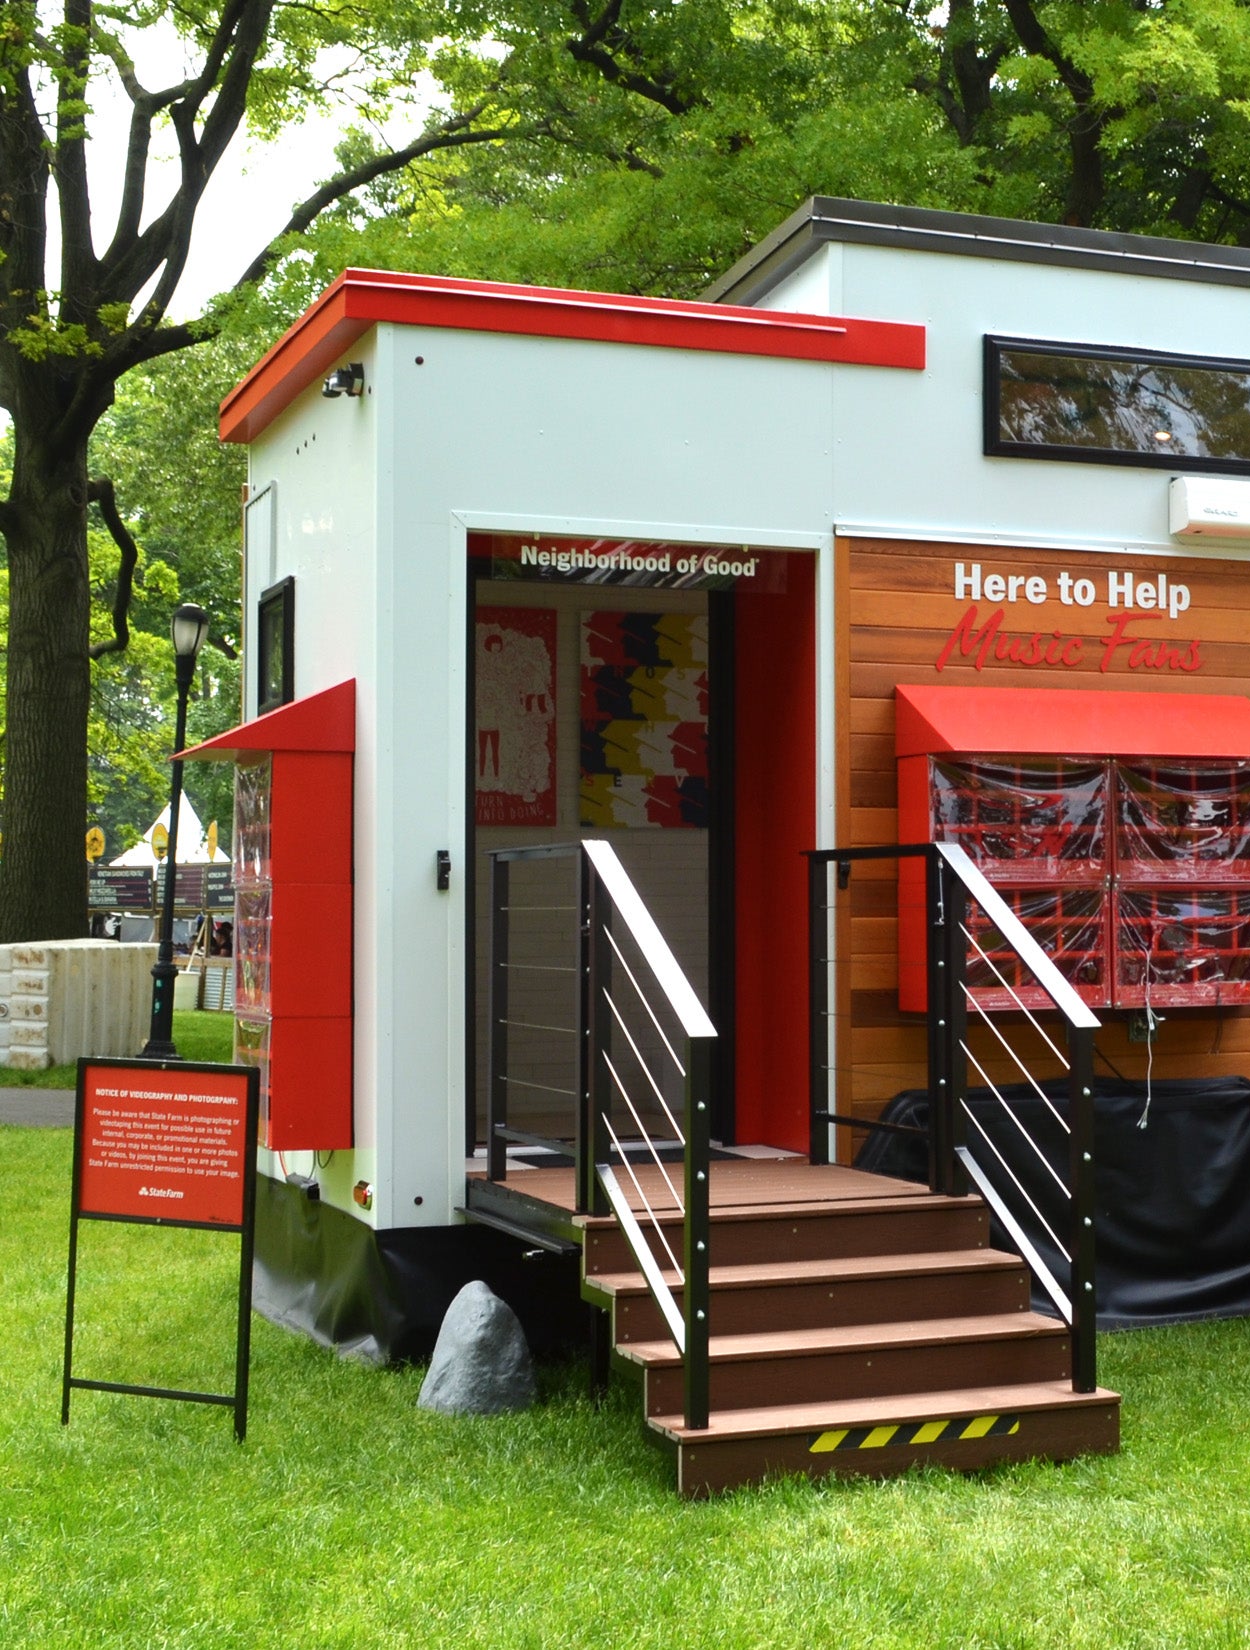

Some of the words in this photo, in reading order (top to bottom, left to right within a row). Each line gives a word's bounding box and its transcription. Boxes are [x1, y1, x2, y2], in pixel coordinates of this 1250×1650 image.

[521, 545, 670, 573] Neighborhood
[677, 555, 698, 574] of
[703, 555, 756, 577] Good
[954, 562, 1048, 605] Here
[1057, 571, 1096, 606] to
[1108, 571, 1191, 619] Help
[935, 604, 1086, 672] Music
[1100, 610, 1205, 673] Fans
[95, 1088, 119, 1097] NOTICE
[119, 1090, 129, 1098] OF
[129, 1090, 173, 1100] VIDEOGRAPHY
[174, 1093, 188, 1102] AND
[93, 1107, 111, 1116] Please
[112, 1109, 120, 1117] be
[139, 1111, 151, 1119] that
[151, 1112, 166, 1120] State
[167, 1112, 183, 1121] Farm
[190, 1116, 232, 1126] photographing
[132, 1121, 143, 1129] this
[160, 1123, 169, 1131] for
[170, 1125, 194, 1133] possible
[92, 1138, 116, 1147] Because
[140, 1142, 149, 1150] be
[149, 1144, 174, 1152] included
[201, 1148, 217, 1156] more
[218, 1149, 238, 1158] photos
[89, 1158, 103, 1167] State
[104, 1159, 119, 1168] Farm
[120, 1162, 154, 1171] unrestricted
[154, 1164, 186, 1174] permission
[205, 1169, 219, 1177] your
[128, 1151, 136, 1160] by
[136, 1153, 156, 1162] joining
[157, 1154, 168, 1162] this
[210, 1159, 228, 1168] giving
